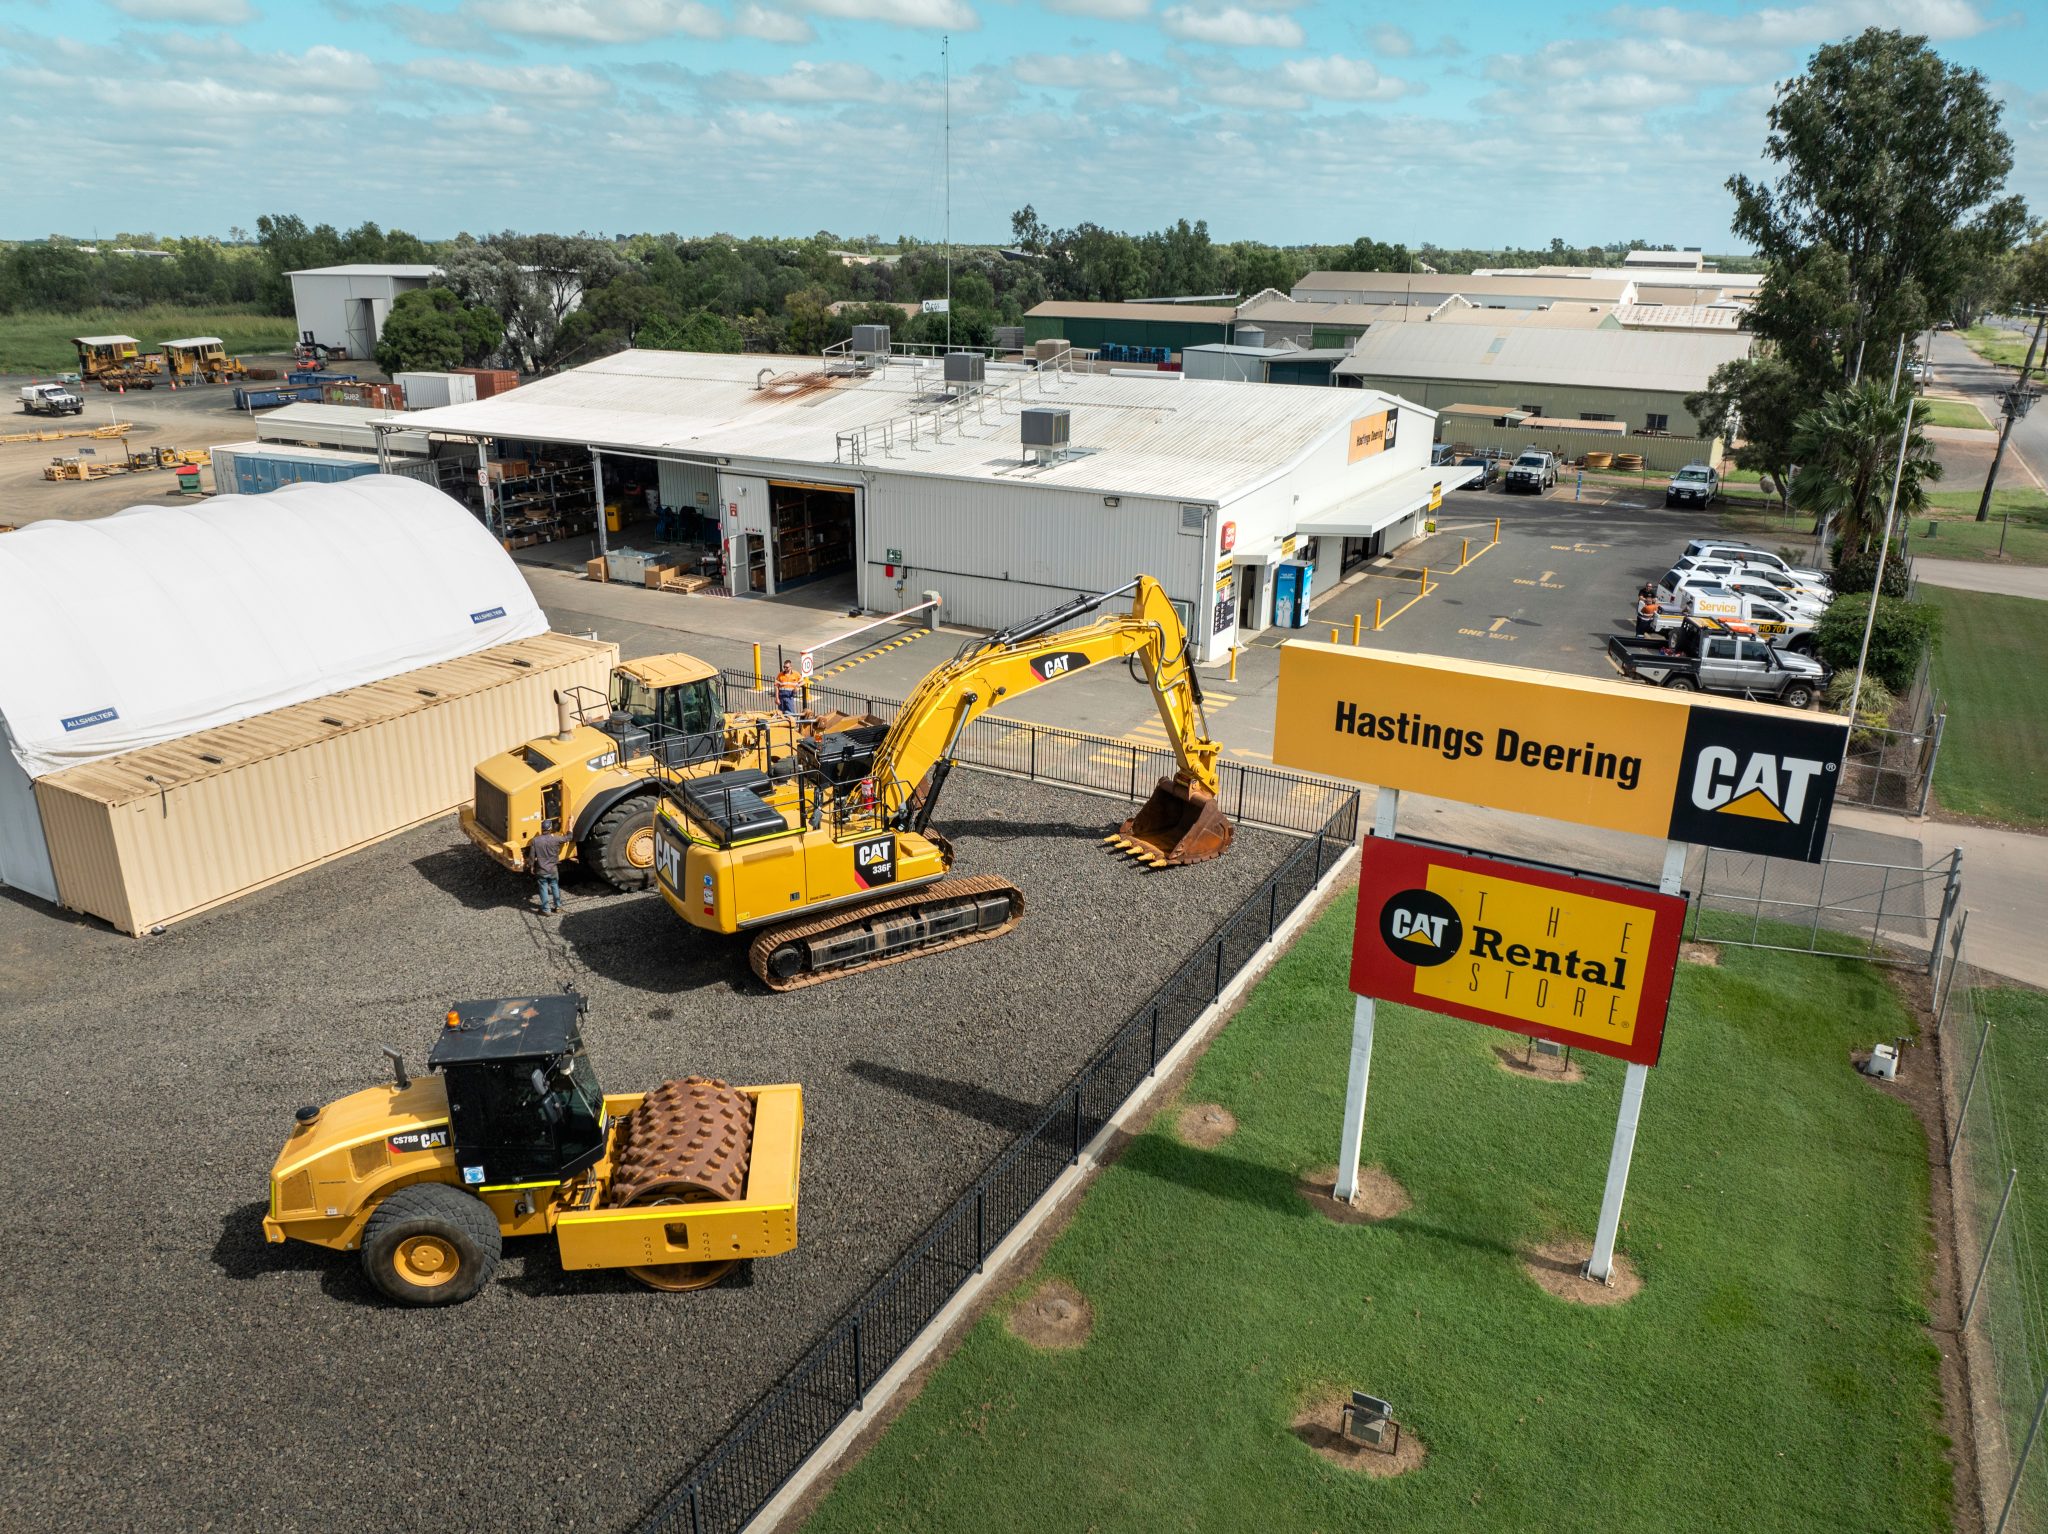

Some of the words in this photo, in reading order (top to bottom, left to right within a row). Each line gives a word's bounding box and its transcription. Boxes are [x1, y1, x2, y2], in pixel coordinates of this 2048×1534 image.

[1385, 418, 1396, 440] CAT
[1512, 578, 1537, 586] ONE
[1699, 600, 1737, 613] Service
[1457, 628, 1486, 637] ONE
[1488, 632, 1518, 641] WAY
[1759, 624, 1772, 633] HD
[1773, 625, 1787, 633] 707
[803, 660, 811, 670] 10
[1044, 654, 1069, 678] CAT
[67, 711, 114, 728] ALLSHELTER
[1335, 701, 1484, 760] Hastings
[1495, 728, 1643, 791] Deering
[601, 752, 616, 767] CAT
[1691, 745, 1824, 825] CAT
[655, 831, 681, 890] CAT
[858, 841, 891, 866] CAT
[872, 863, 891, 874] 336F
[1391, 908, 1449, 949] CAT
[1477, 891, 1634, 955] THE
[1469, 925, 1627, 991] Rental
[1468, 962, 1620, 1027] STORE
[392, 1135, 419, 1145] CS78B
[420, 1131, 447, 1148] CAT
